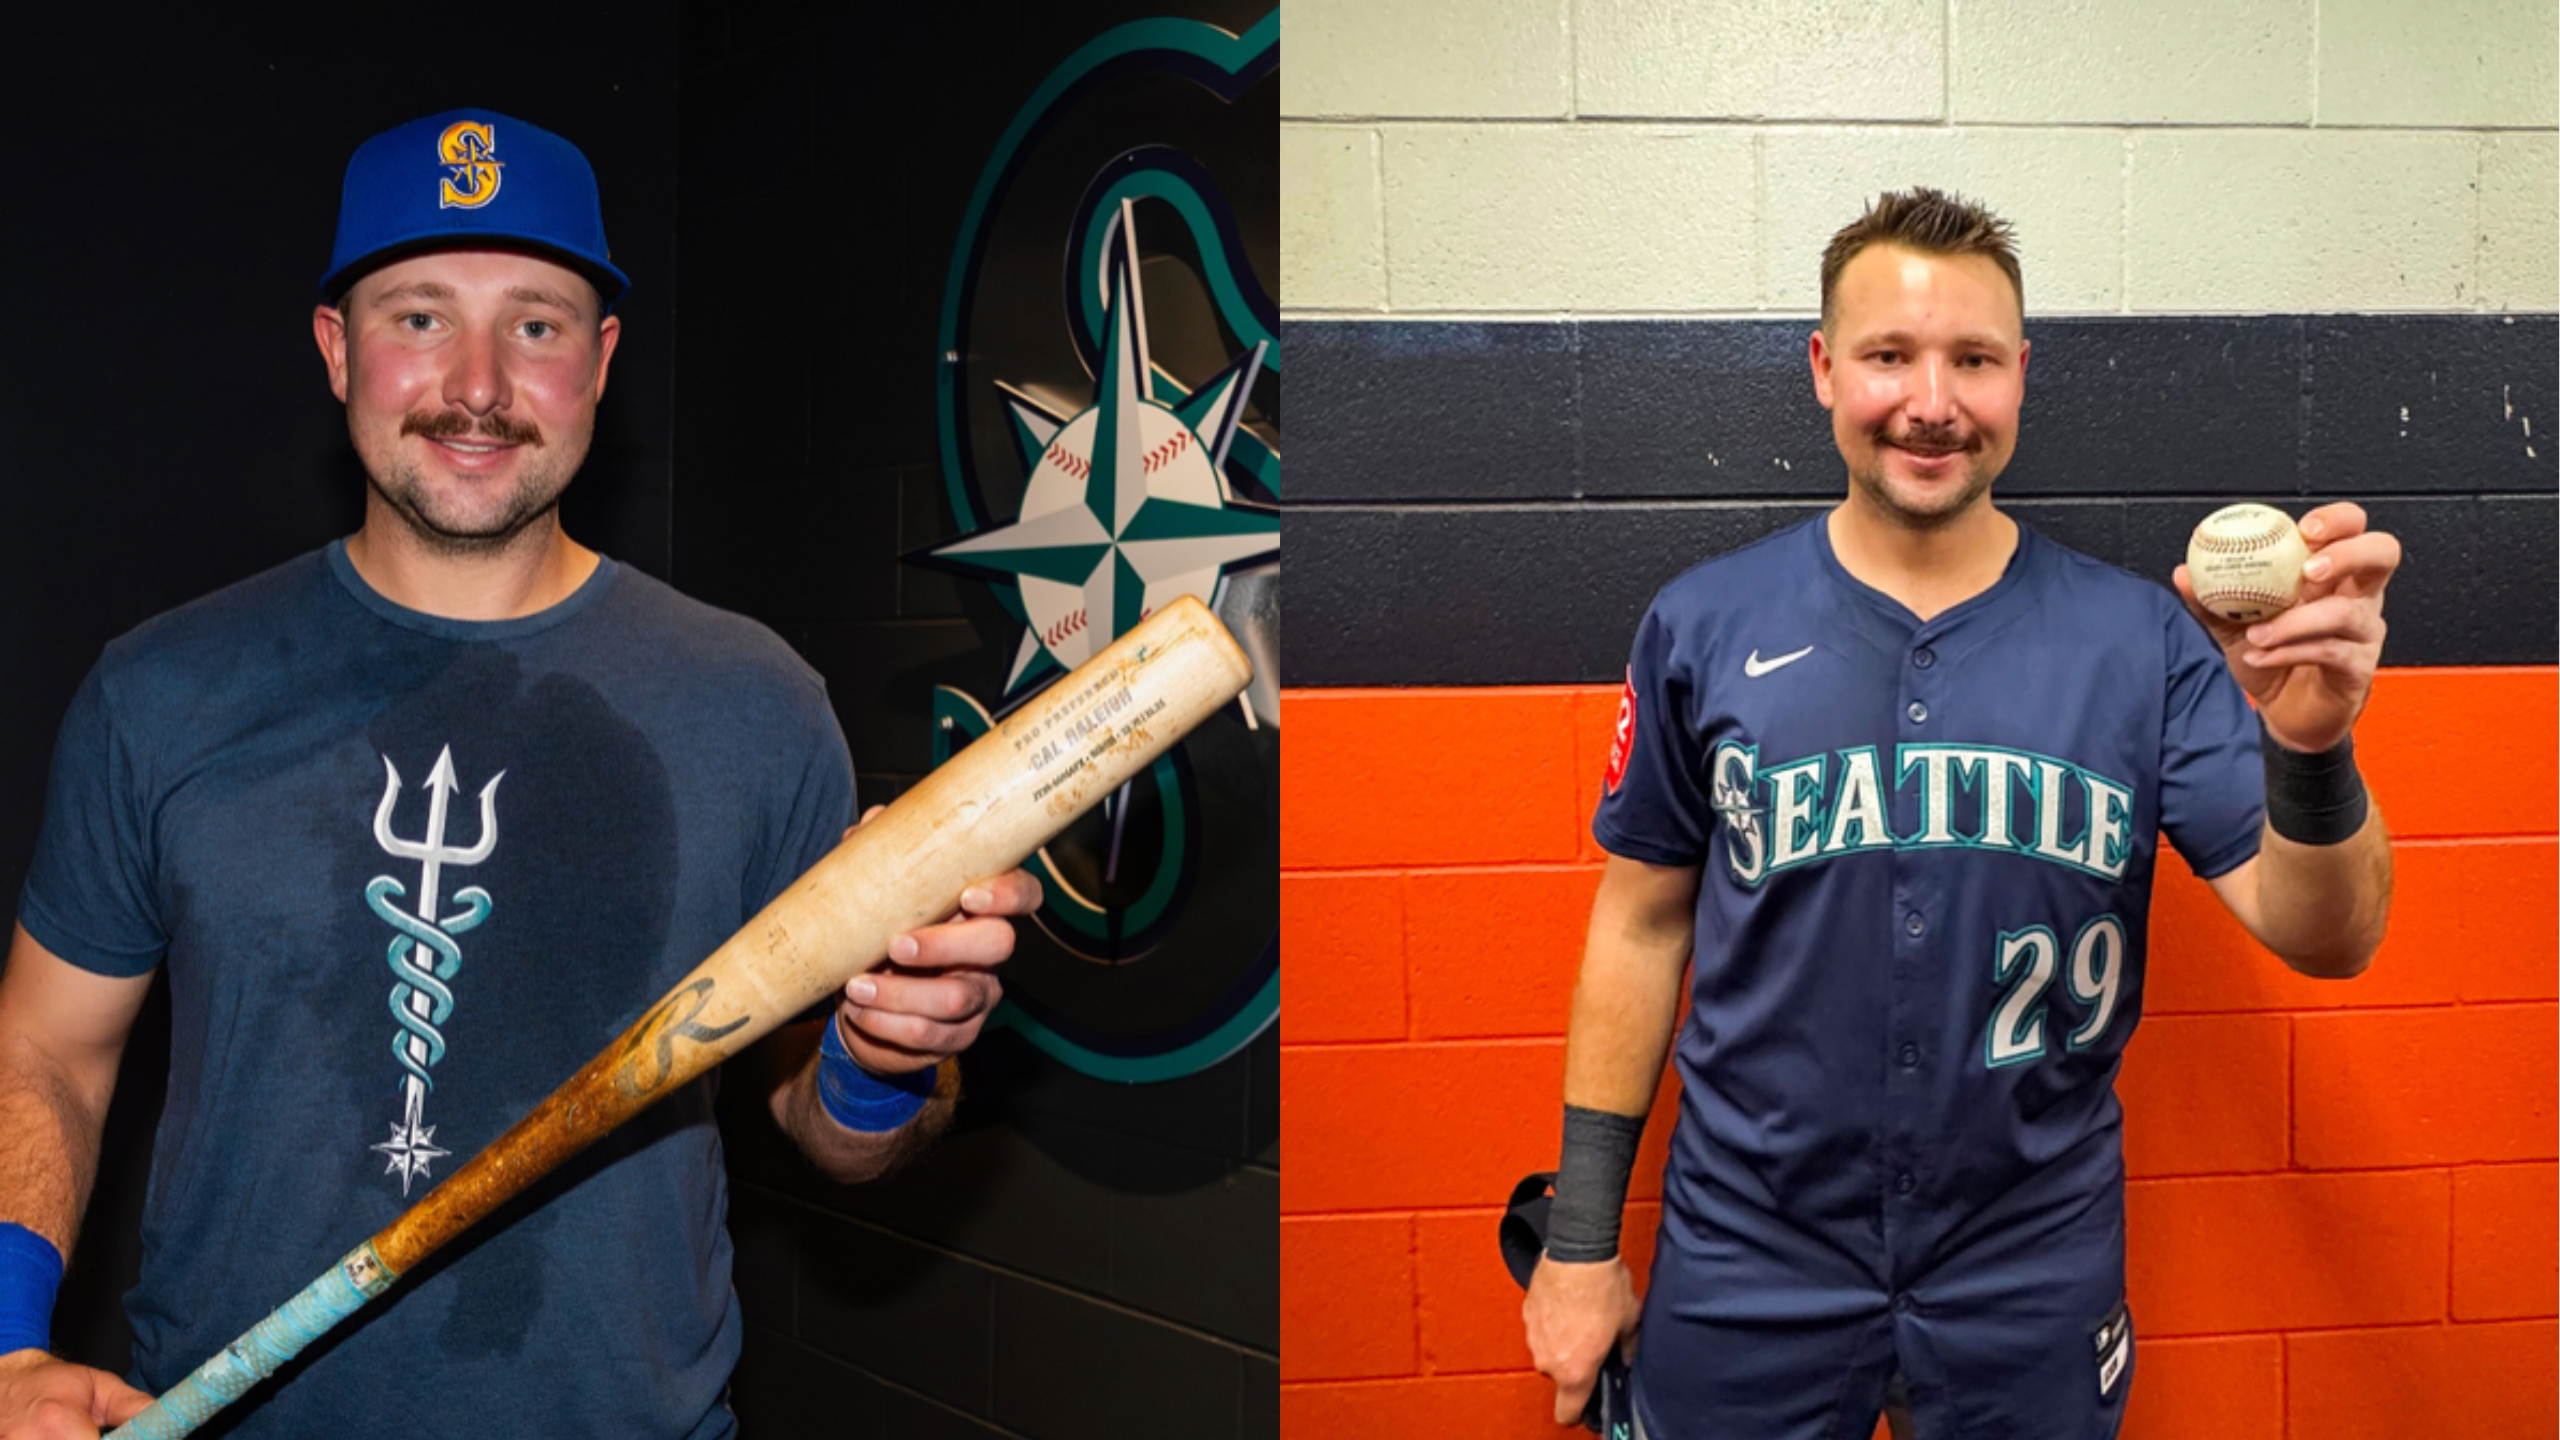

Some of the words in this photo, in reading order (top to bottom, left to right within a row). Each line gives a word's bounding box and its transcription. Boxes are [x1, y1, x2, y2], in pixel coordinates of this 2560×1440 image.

[438, 121, 505, 209] S
[1029, 742, 1064, 771] CAL
[1064, 686, 1134, 747] RALEIGH
[1712, 740, 2134, 886] SEATTLE
[1985, 913, 2127, 1069] 29
